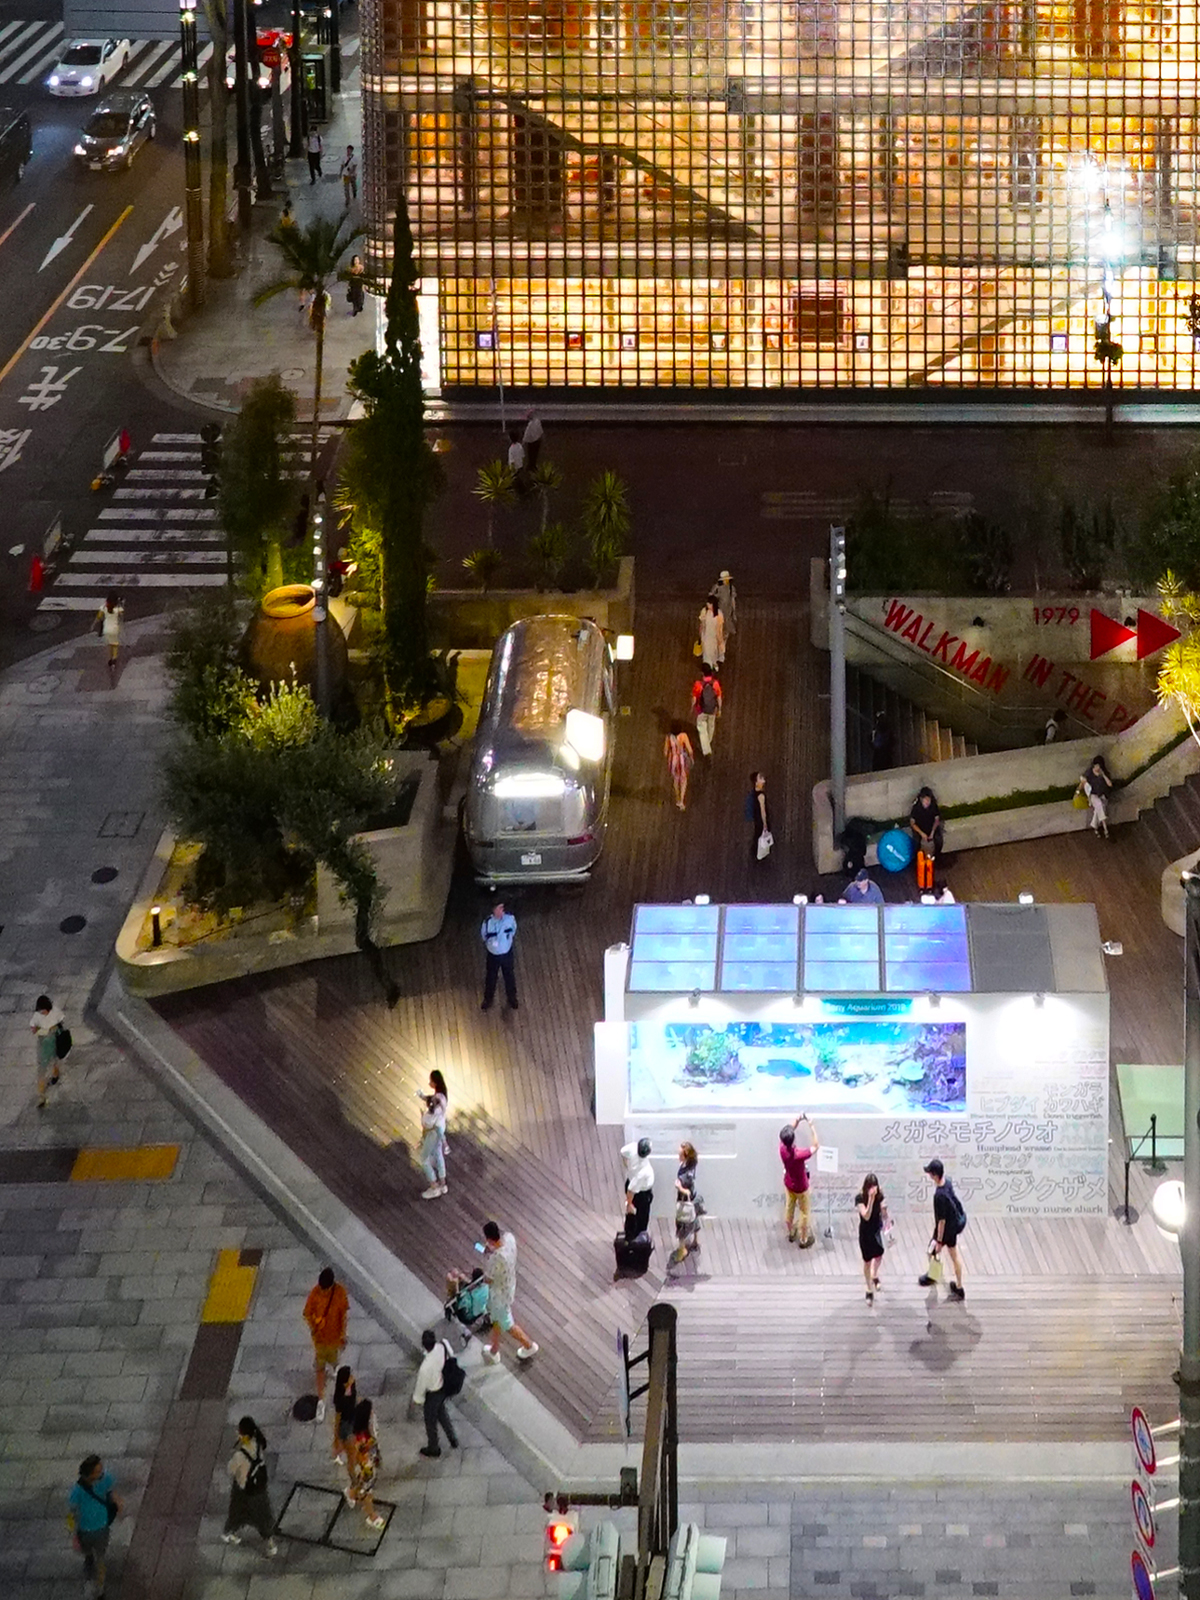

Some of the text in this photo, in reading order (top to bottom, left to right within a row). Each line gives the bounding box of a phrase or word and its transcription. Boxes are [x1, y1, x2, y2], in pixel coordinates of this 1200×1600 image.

[1033, 607, 1081, 626] 1979
[883, 599, 1011, 695] WALKMAN
[1022, 653, 1055, 688] IN
[1055, 671, 1108, 721] THE
[847, 1003, 886, 1012] Aquarium
[881, 1119, 1058, 1144] メガネモチノウオ
[907, 1174, 1106, 1202] オテンジクザメ
[1006, 1204, 1104, 1214] Tawny nurse shark
